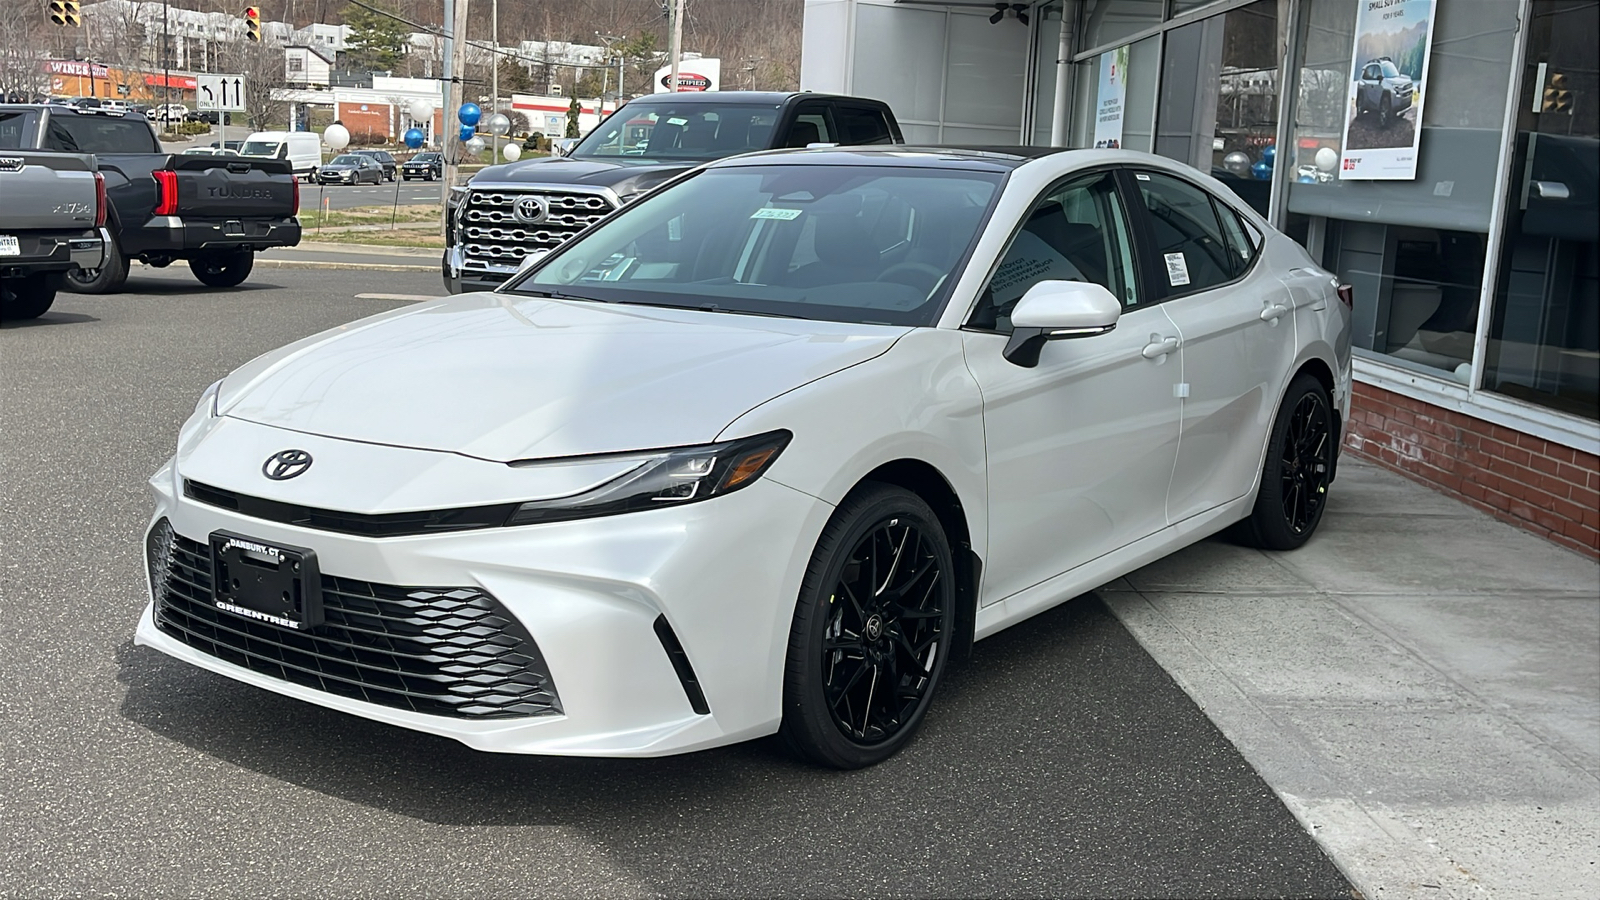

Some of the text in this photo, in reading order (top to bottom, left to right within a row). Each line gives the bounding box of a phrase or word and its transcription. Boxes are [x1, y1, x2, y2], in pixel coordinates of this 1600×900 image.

[1368, 1, 1384, 11] SMALL
[51, 61, 89, 75] WINES
[666, 78, 706, 86] CRTIFIED
[200, 100, 215, 108] ONLY
[207, 186, 273, 199] TUNDRA
[63, 202, 91, 213] 1794
[230, 539, 280, 557] DANBURY, CT
[216, 601, 300, 629] GREENTREE
